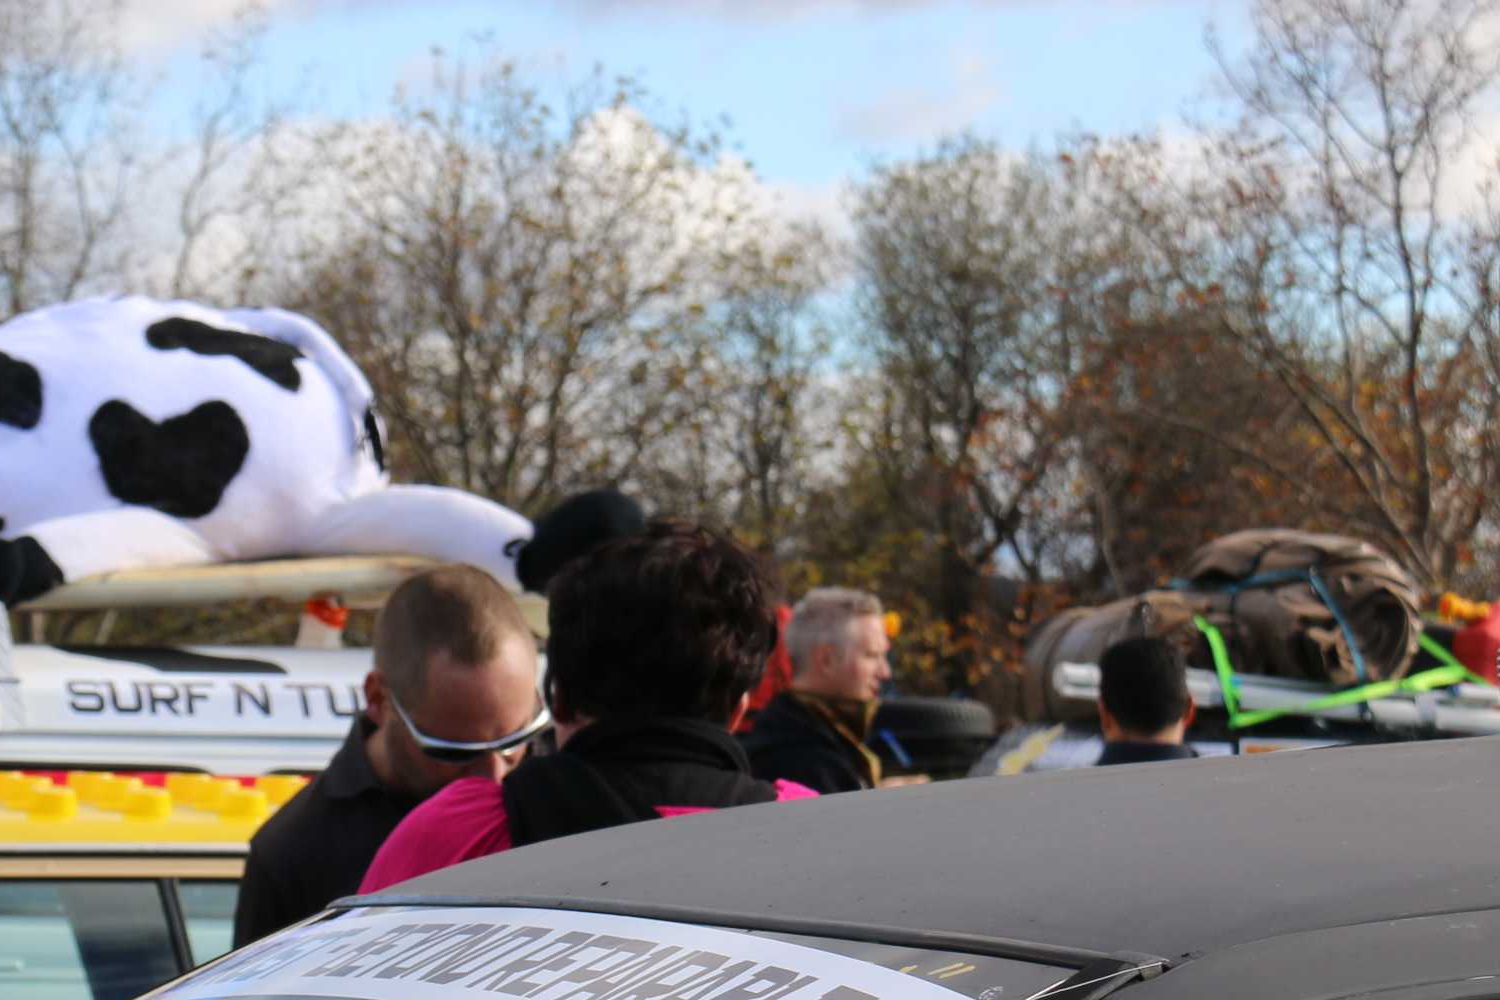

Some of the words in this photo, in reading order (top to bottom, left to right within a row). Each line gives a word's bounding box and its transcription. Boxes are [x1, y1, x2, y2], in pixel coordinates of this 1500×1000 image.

[66, 679, 213, 717] SURF
[231, 681, 274, 718] N
[298, 922, 556, 986] BEYOND
